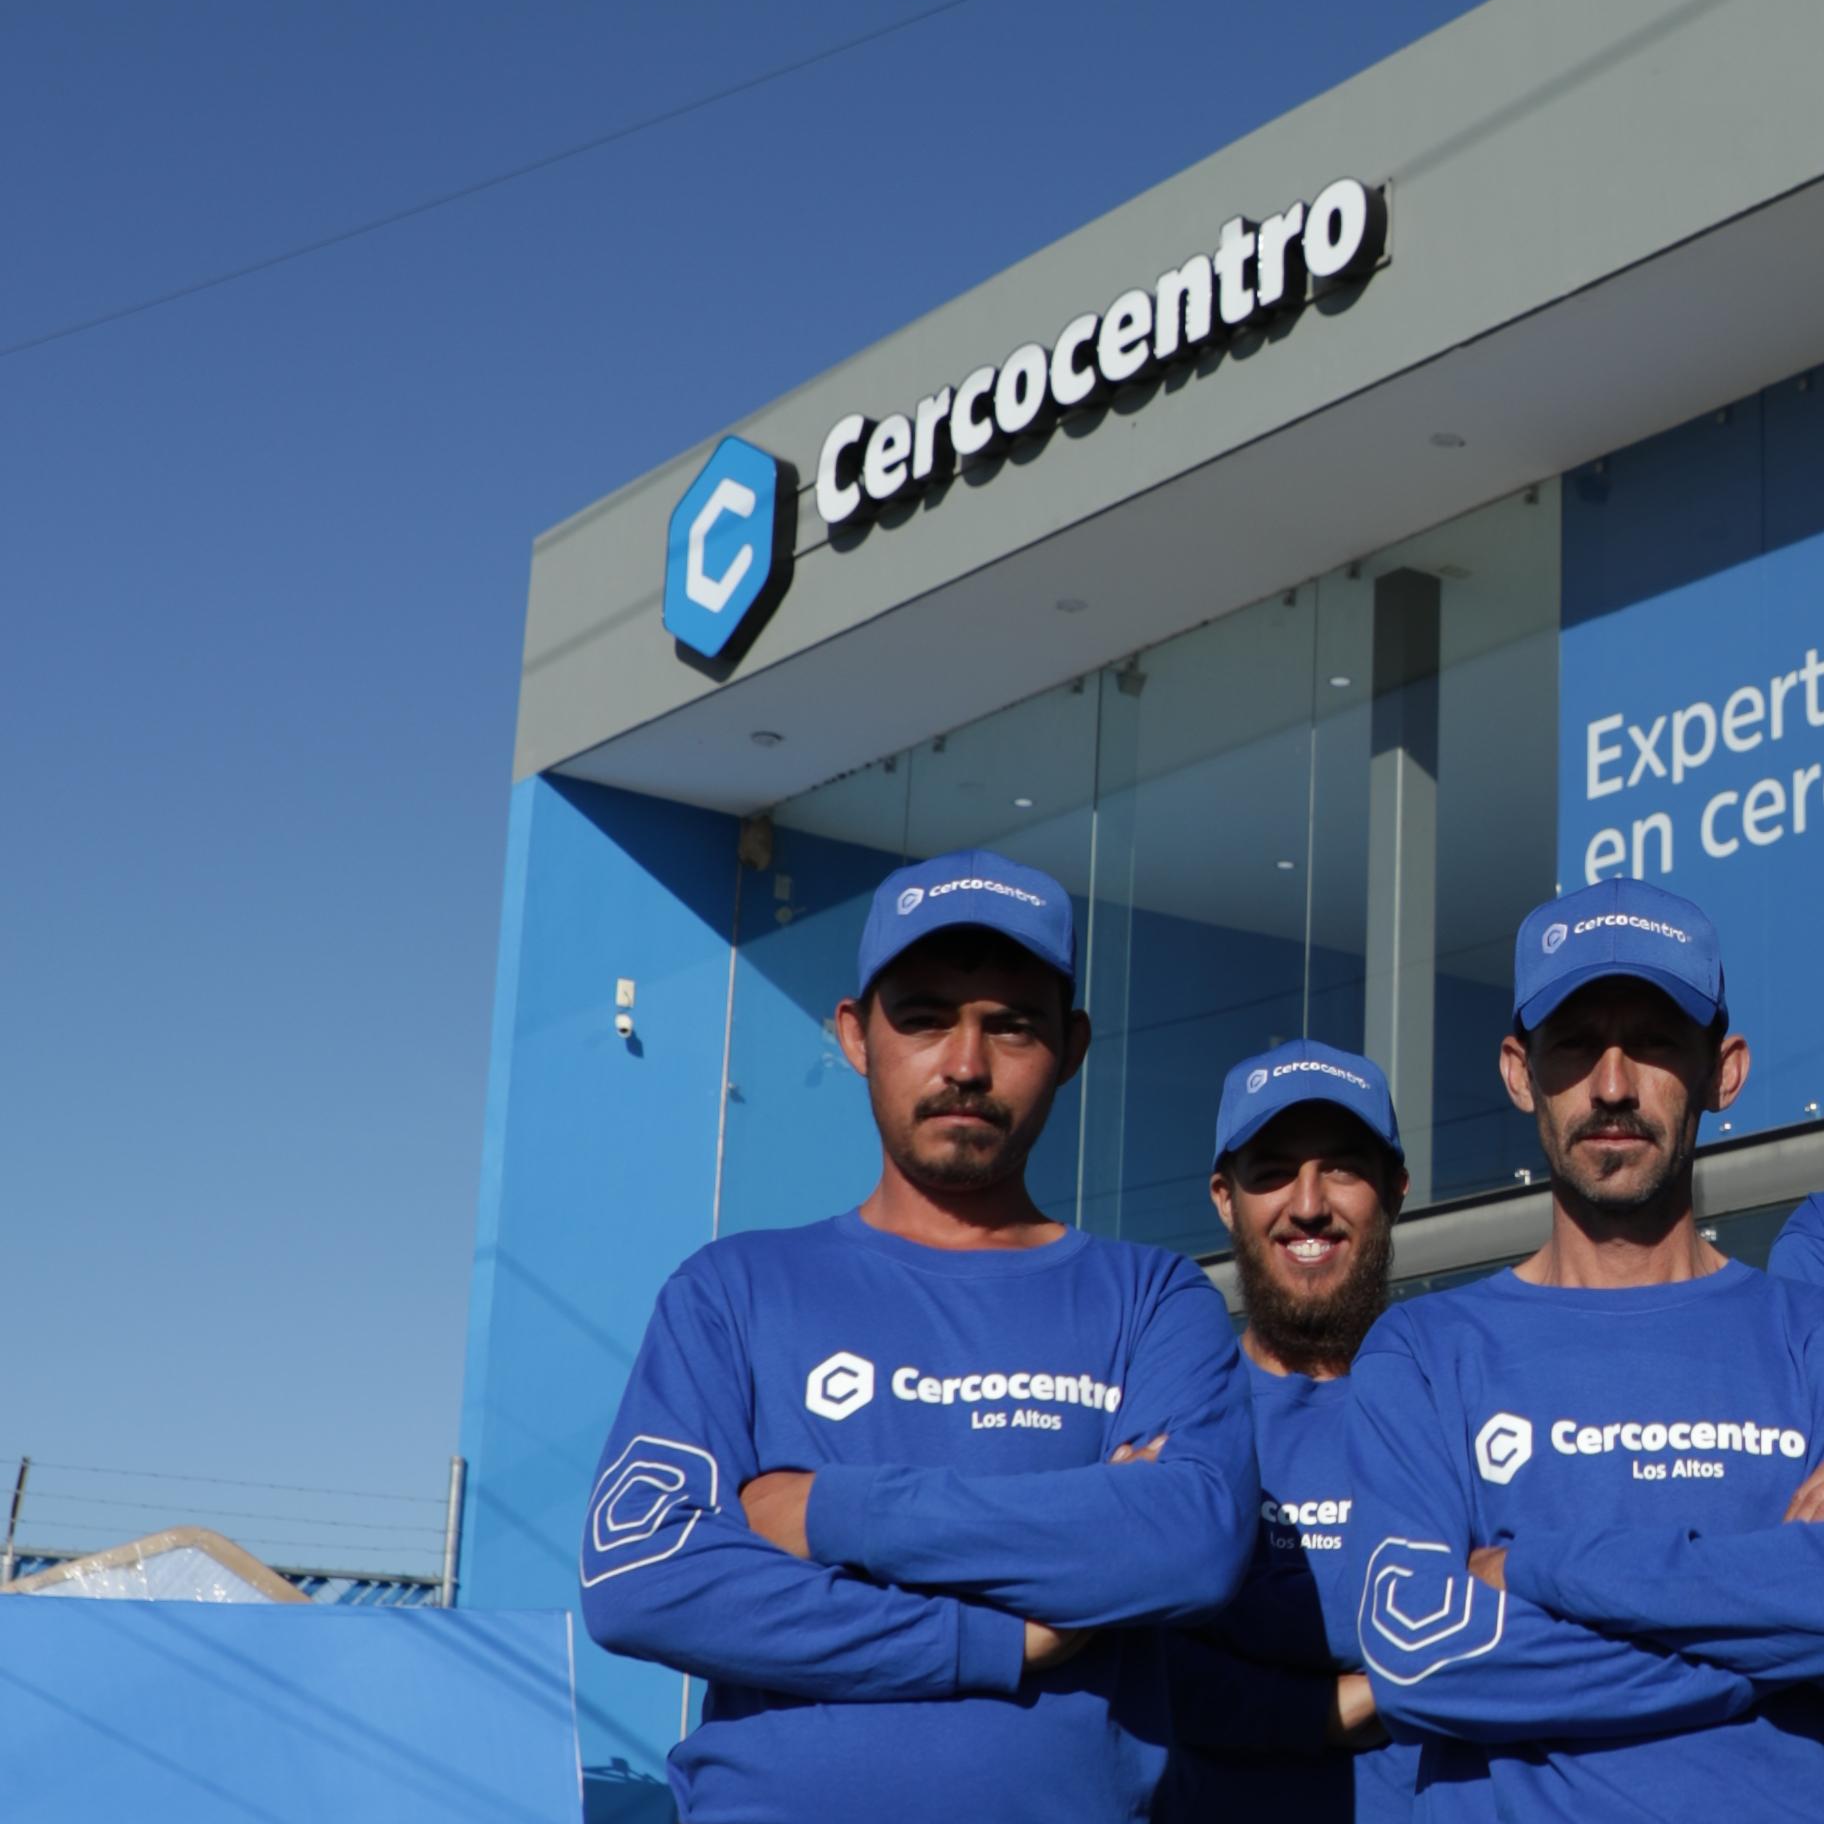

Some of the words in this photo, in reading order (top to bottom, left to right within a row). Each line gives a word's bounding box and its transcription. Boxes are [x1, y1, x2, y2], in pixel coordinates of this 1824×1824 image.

[815, 178, 1367, 524] Cercocentro
[1584, 811, 1674, 886] en
[892, 1367, 1122, 1413] Cercocentro
[971, 1411, 1006, 1429] Los
[1011, 1409, 1062, 1430] Altos
[1551, 1420, 1806, 1458] Cercocentro
[1633, 1460, 1667, 1480] Los
[1672, 1459, 1724, 1479] Altos
[1301, 1533, 1342, 1549] Altos
